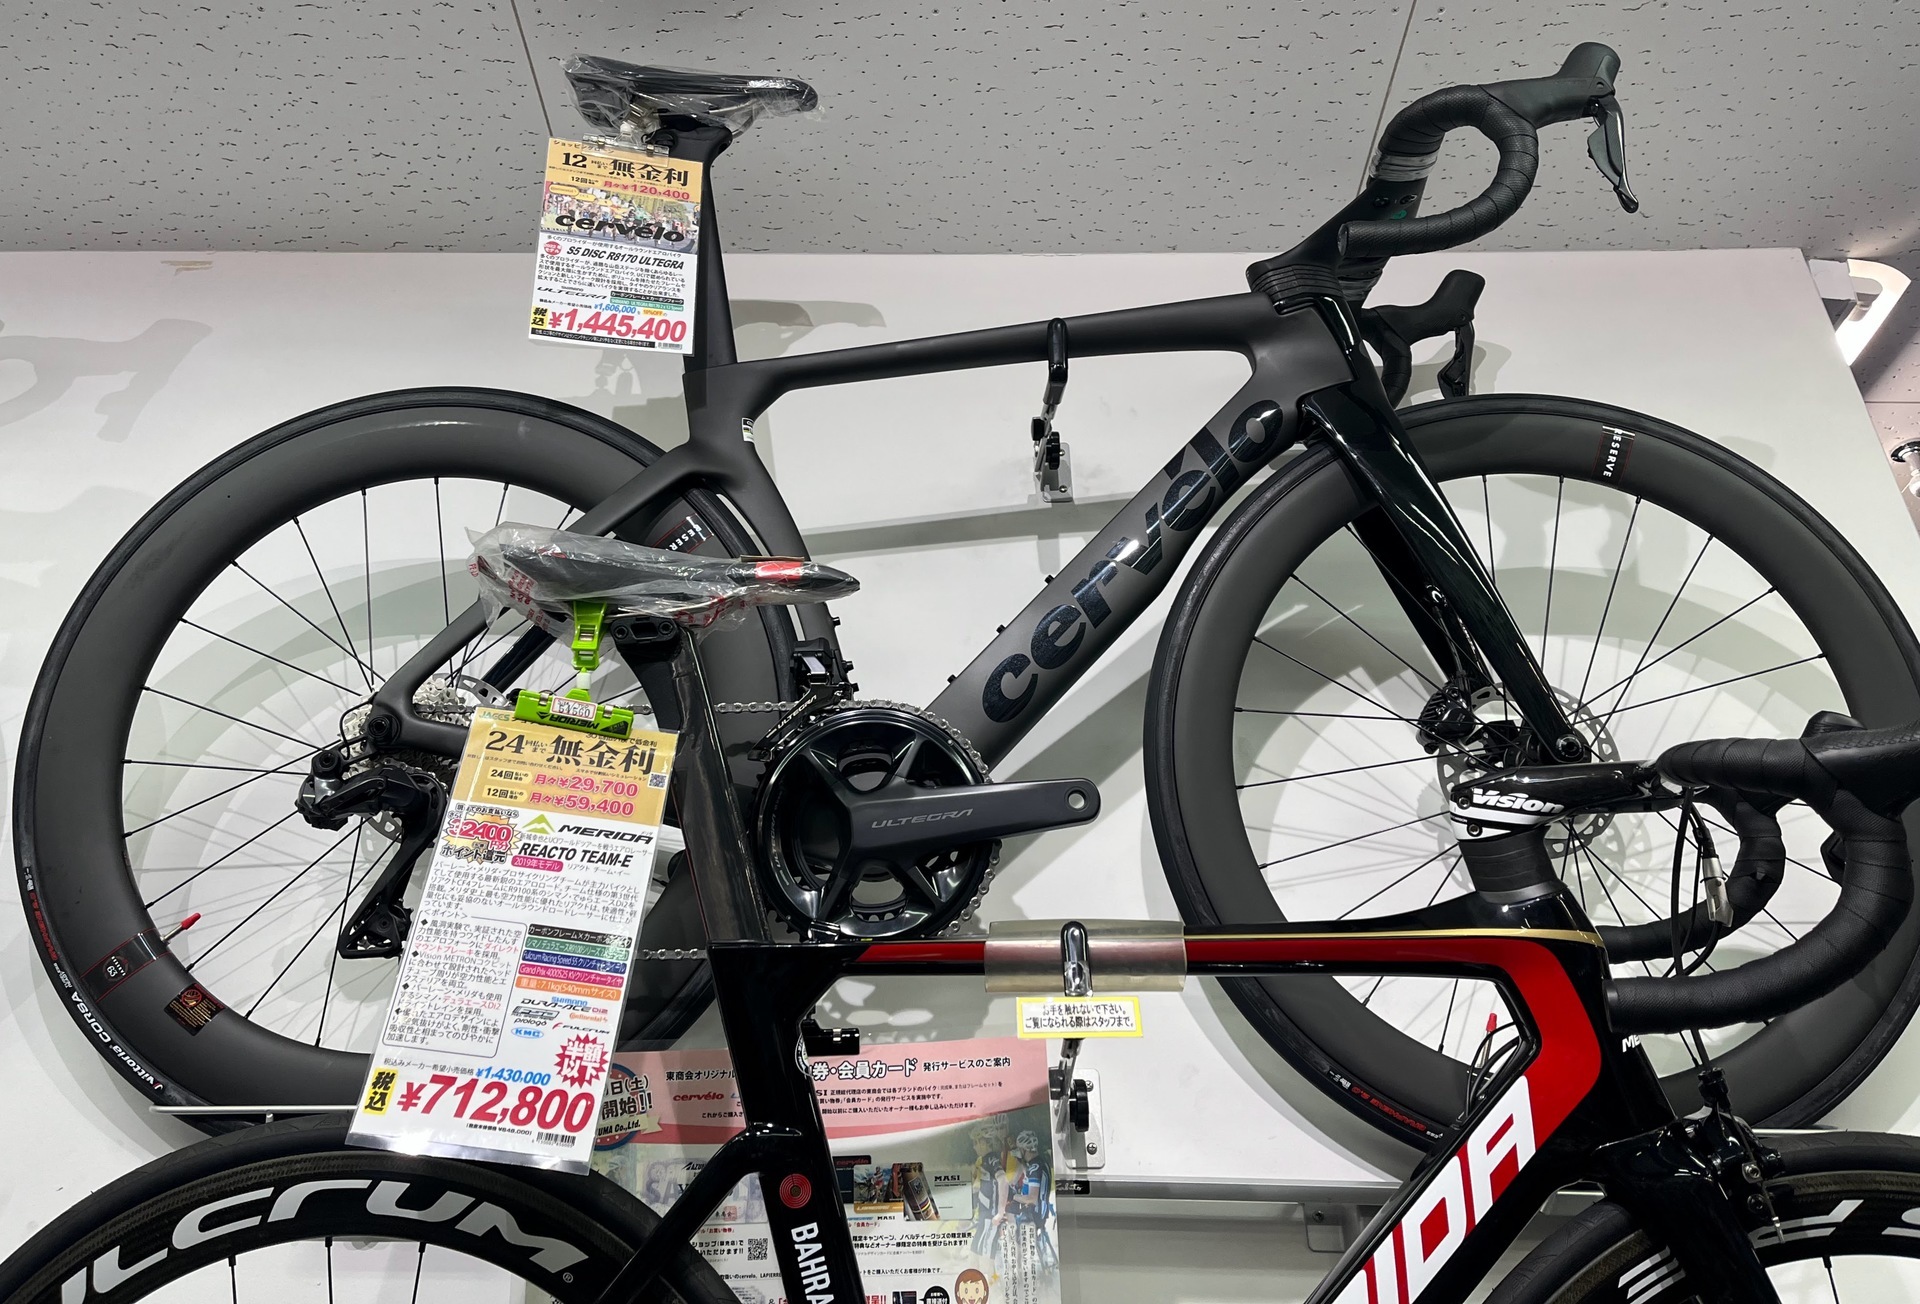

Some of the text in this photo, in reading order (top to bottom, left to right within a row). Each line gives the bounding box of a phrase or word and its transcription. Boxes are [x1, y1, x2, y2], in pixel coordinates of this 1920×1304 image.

[561, 151, 587, 168] 12
[608, 158, 689, 187] 無金利
[566, 245, 579, 255] S5
[581, 247, 605, 259] DISC
[606, 251, 637, 263] R8170
[638, 255, 684, 269] ULTEGRA
[594, 302, 636, 314] ¥1,606,000
[548, 306, 687, 342] ¥1,445,400
[1603, 428, 1624, 478] RESERVE
[484, 730, 528, 754] 24
[545, 734, 657, 775] 無金利
[489, 769, 514, 779] 24回
[533, 771, 639, 796] 月々¥29,700
[485, 788, 509, 798] 12回
[528, 790, 635, 817] 月々¥59,400
[1473, 787, 1565, 814] Vision
[871, 808, 974, 829] ULTEGRA
[557, 823, 654, 845] MERIDA
[440, 844, 507, 863] ポイント還元
[512, 857, 560, 871] 2019年モデル
[517, 842, 633, 868] REACTO TEAM-E
[422, 898, 465, 910] っています。
[412, 941, 502, 959] マウントブレーキを採用。
[417, 950, 443, 961] Vision
[407, 957, 511, 978] に合わせて設計されたヘッド
[402, 973, 469, 989] クステリアを両立。
[520, 998, 591, 1012] DURA-ACE
[550, 996, 588, 1006] SHIMANO
[1042, 1004, 1127, 1016] お手を触れないで下さい。
[70, 991, 110, 1044] CORSA
[1025, 1016, 1134, 1029] ご覧になられる際はスタッフまで。
[385, 1030, 432, 1045] 加速します。
[388, 1023, 494, 1044] 吸収性と相まってのびやかに
[513, 1028, 541, 1037] KMC
[563, 1041, 604, 1062] 半額
[382, 1056, 474, 1076] 税込みメーカー希望小売価格
[474, 1064, 551, 1086] ¥1,430,000
[559, 1058, 600, 1080] 以下
[922, 1056, 1012, 1073] 発行サービスのご案内
[364, 1071, 391, 1108] 税込
[394, 1071, 582, 1127] ¥712,800
